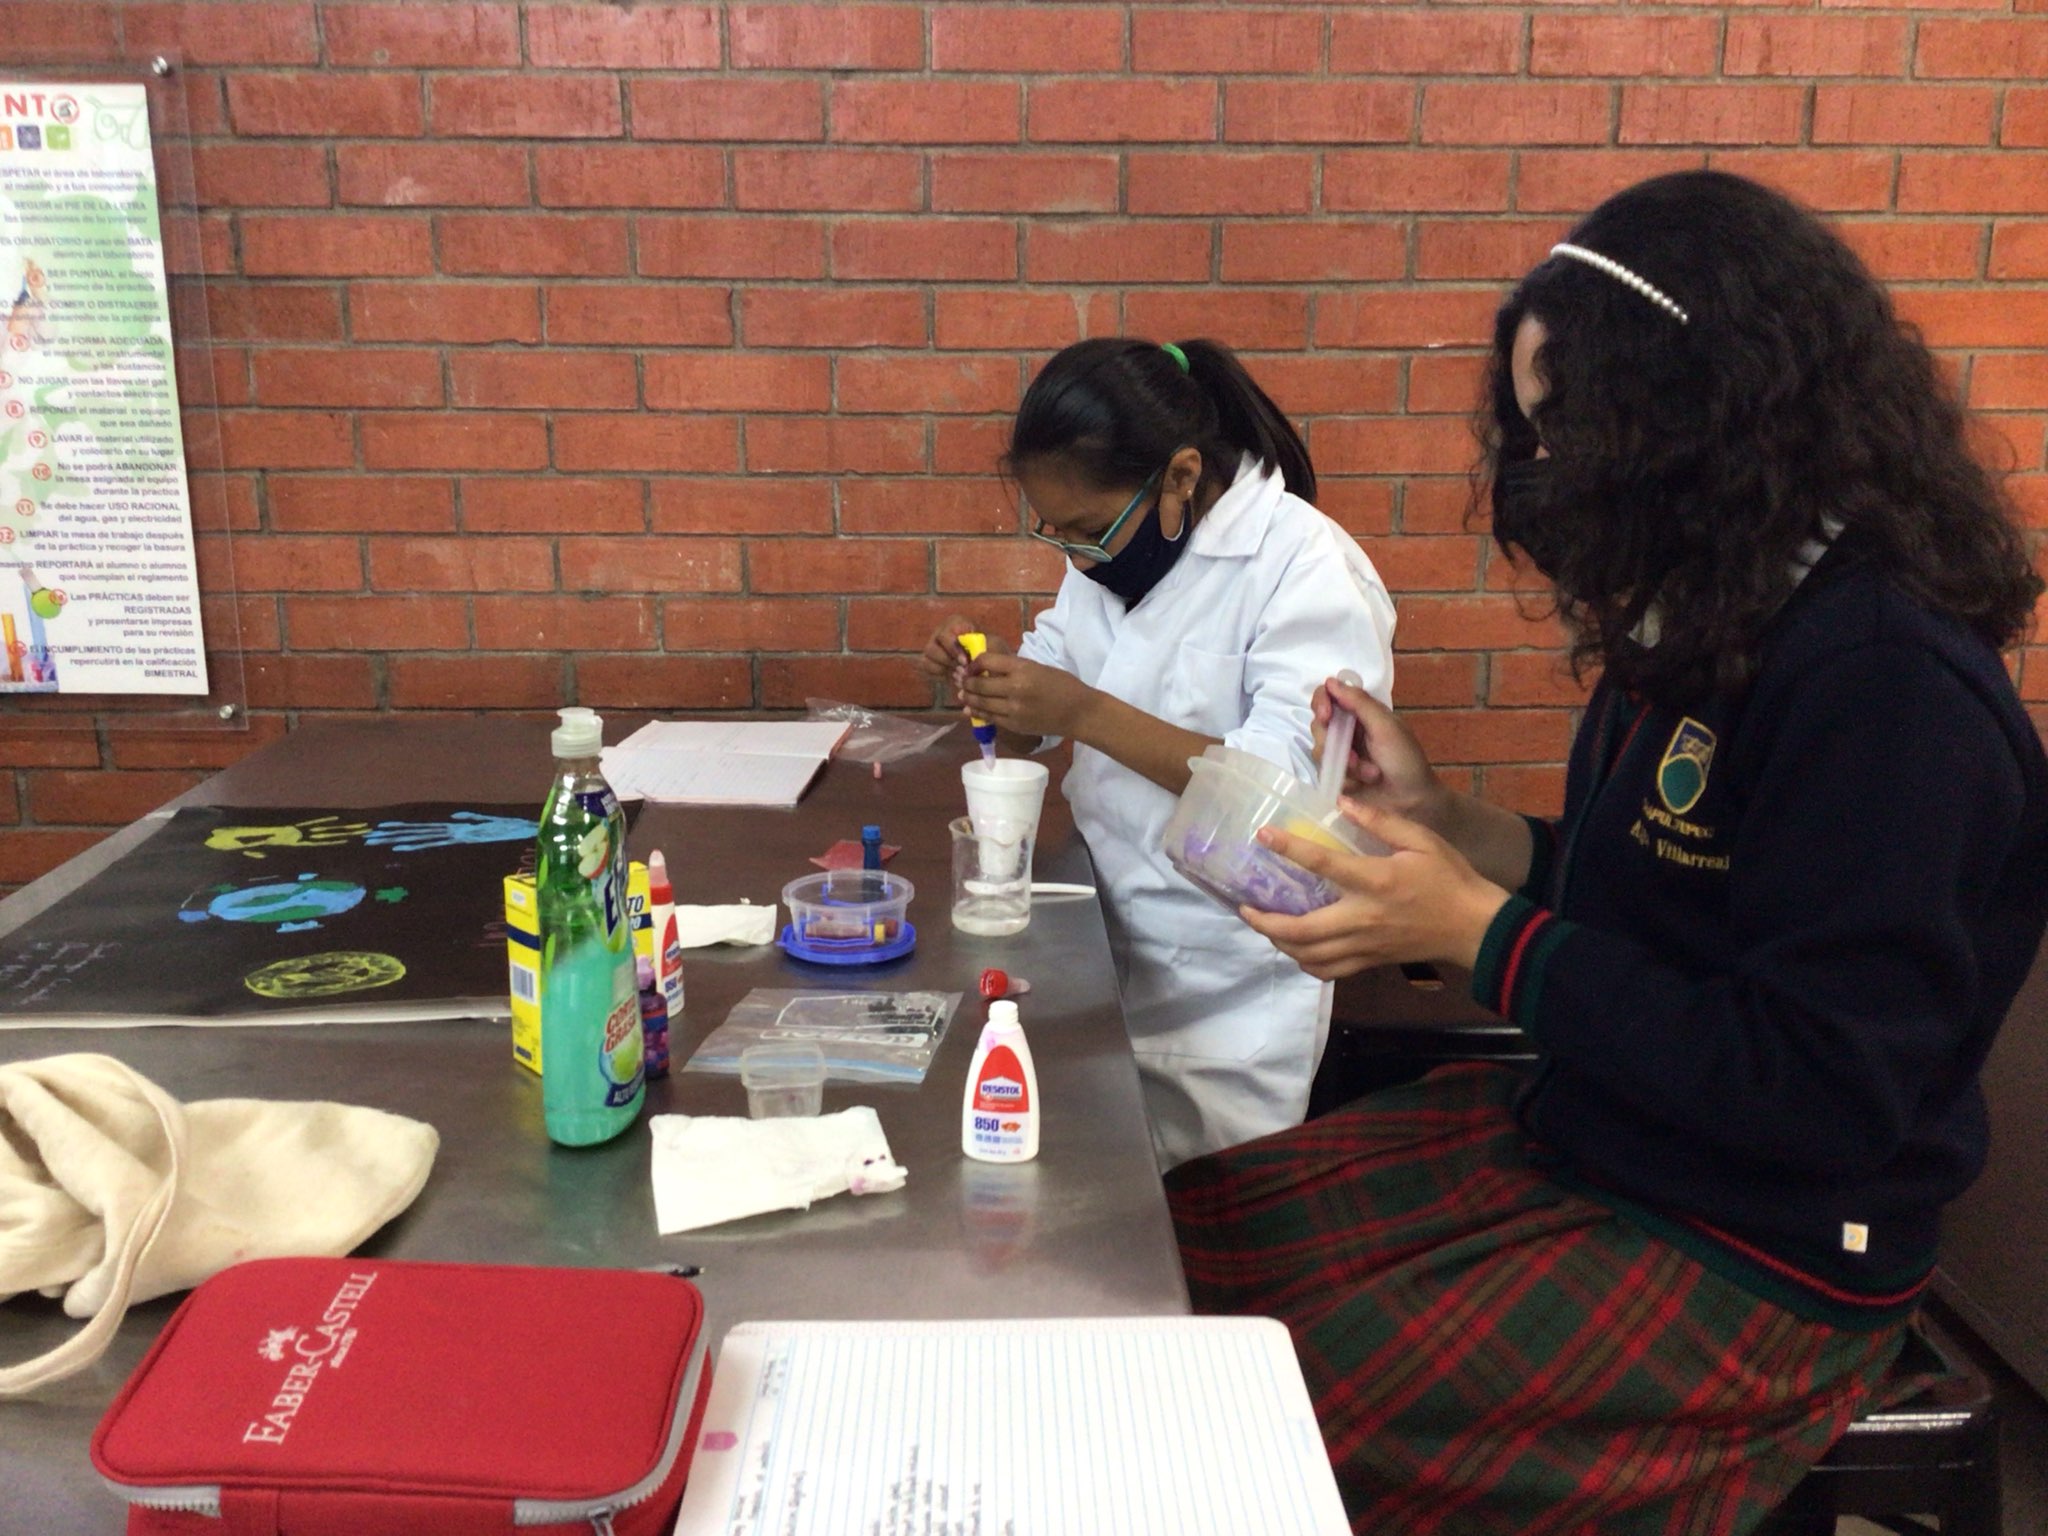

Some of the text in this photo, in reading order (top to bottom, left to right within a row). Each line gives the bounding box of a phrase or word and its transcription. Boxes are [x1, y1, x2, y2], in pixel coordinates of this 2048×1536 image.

[127, 238, 153, 247] BATA
[70, 269, 114, 279] PUNTUAL
[72, 337, 106, 345] FORMA
[109, 337, 163, 345] ADECUADA
[18, 377, 33, 385] NO
[36, 377, 69, 385] JUGAR
[75, 390, 121, 398] contactos
[90, 407, 127, 415] material
[51, 434, 82, 442] LAVAR
[96, 435, 132, 443] material
[79, 448, 122, 456] colocarlo
[151, 448, 174, 458] lugar
[115, 463, 177, 471] ABANDONAR
[93, 475, 134, 485] asignada
[147, 476, 178, 486] equipo
[93, 487, 129, 495] durante
[131, 487, 139, 495] la
[41, 502, 52, 510] Se
[55, 502, 77, 510] debe
[80, 502, 105, 510] hacer
[108, 503, 128, 511] USO
[132, 503, 181, 511] RACIONAL
[102, 517, 118, 525] gas
[128, 515, 182, 524] electricidad
[20, 530, 59, 538] LIMPIAR
[98, 531, 109, 539] de
[111, 531, 143, 541] trabajo
[48, 542, 56, 550] la
[106, 544, 142, 553] recoger
[153, 543, 185, 551] basura
[107, 561, 139, 569] alumno
[150, 561, 187, 570] alumnos
[59, 573, 188, 583] que incumplan el reglamento
[70, 592, 86, 601] Las
[89, 590, 144, 601] PRÁCTICAS
[146, 593, 173, 601] deben
[124, 605, 191, 614] REGISTRADAS
[152, 617, 192, 627] impresas
[123, 630, 144, 638] para
[42, 645, 123, 654] INCUMPLIMIENTO
[138, 646, 150, 654] las
[144, 670, 198, 678] BIMESTRAL
[982, 1084, 1020, 1095] RESISTOL
[974, 1117, 1000, 1132] 850
[242, 1271, 378, 1446] FABER-CASTELL
